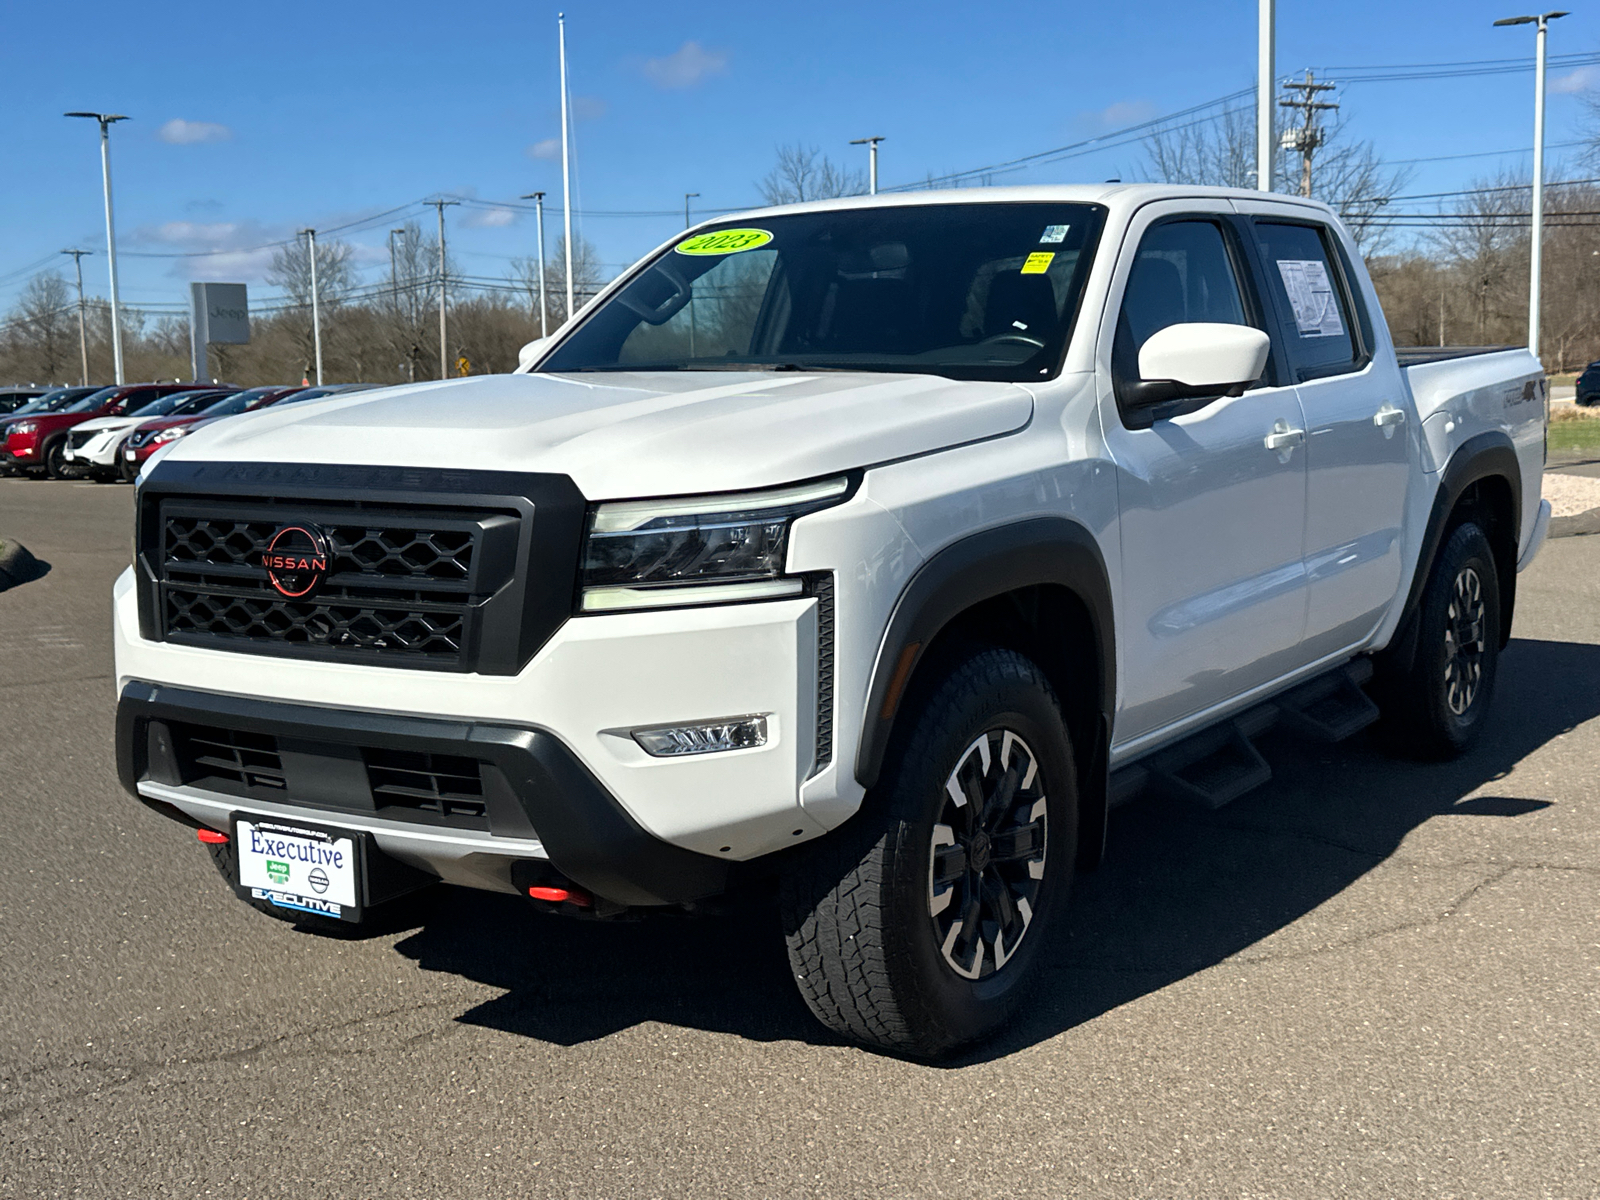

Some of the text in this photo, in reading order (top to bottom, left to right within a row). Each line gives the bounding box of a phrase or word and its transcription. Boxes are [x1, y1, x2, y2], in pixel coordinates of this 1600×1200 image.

[685, 234, 761, 250] 2023
[210, 307, 245, 322] Jeep
[262, 555, 326, 571] NISSAN
[250, 829, 343, 869] Executive
[269, 863, 287, 873] Jeep
[251, 888, 341, 914] EXECUTIVE
